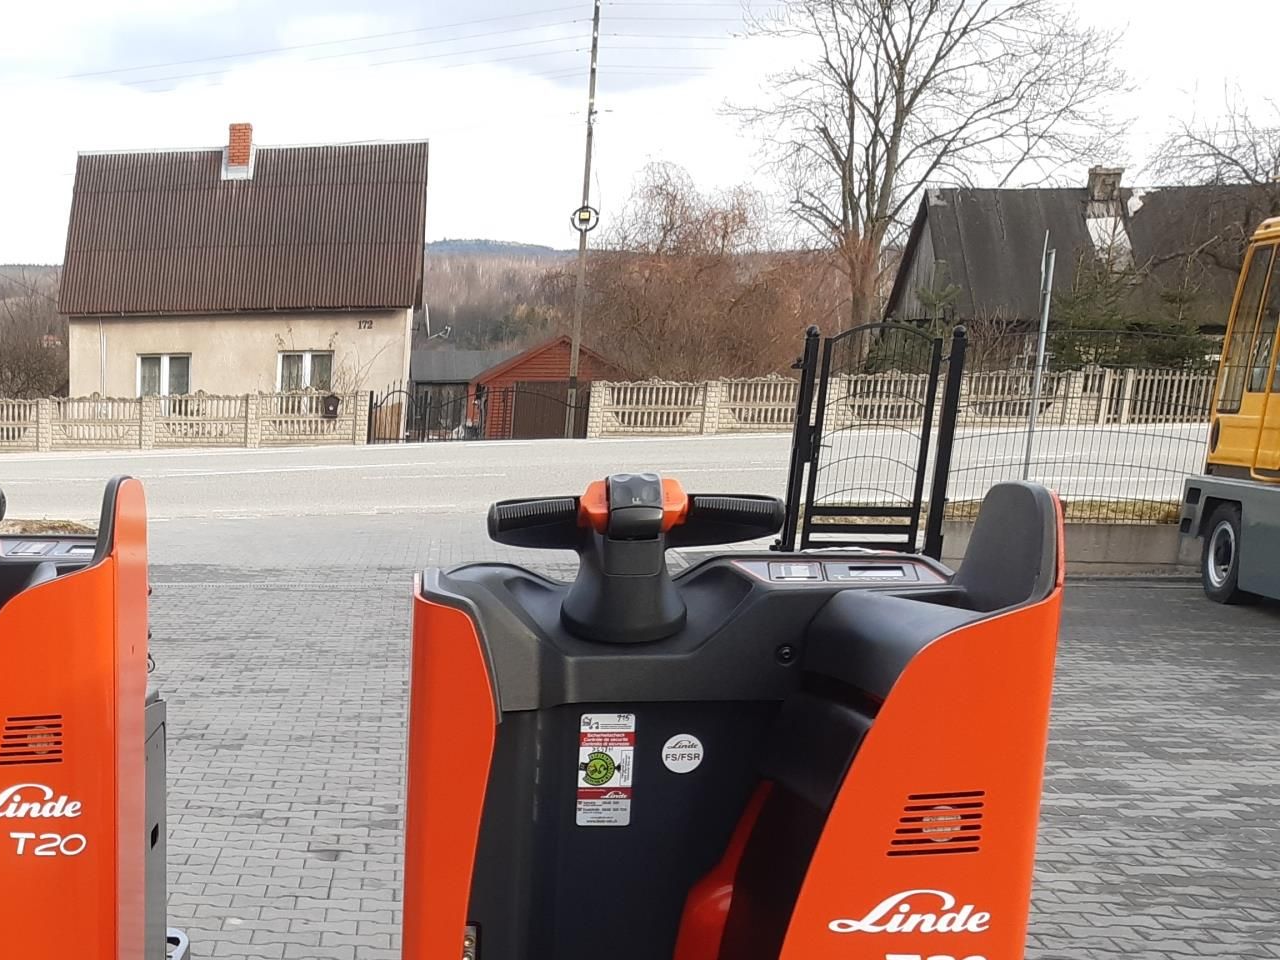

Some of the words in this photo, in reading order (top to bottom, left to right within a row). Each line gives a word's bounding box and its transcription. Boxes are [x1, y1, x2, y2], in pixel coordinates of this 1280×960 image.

[357, 319, 373, 330] 172
[666, 739, 699, 749] Linde
[665, 753, 701, 761] FS/FSR
[9, 832, 87, 856] T20
[828, 889, 991, 933] Linde
